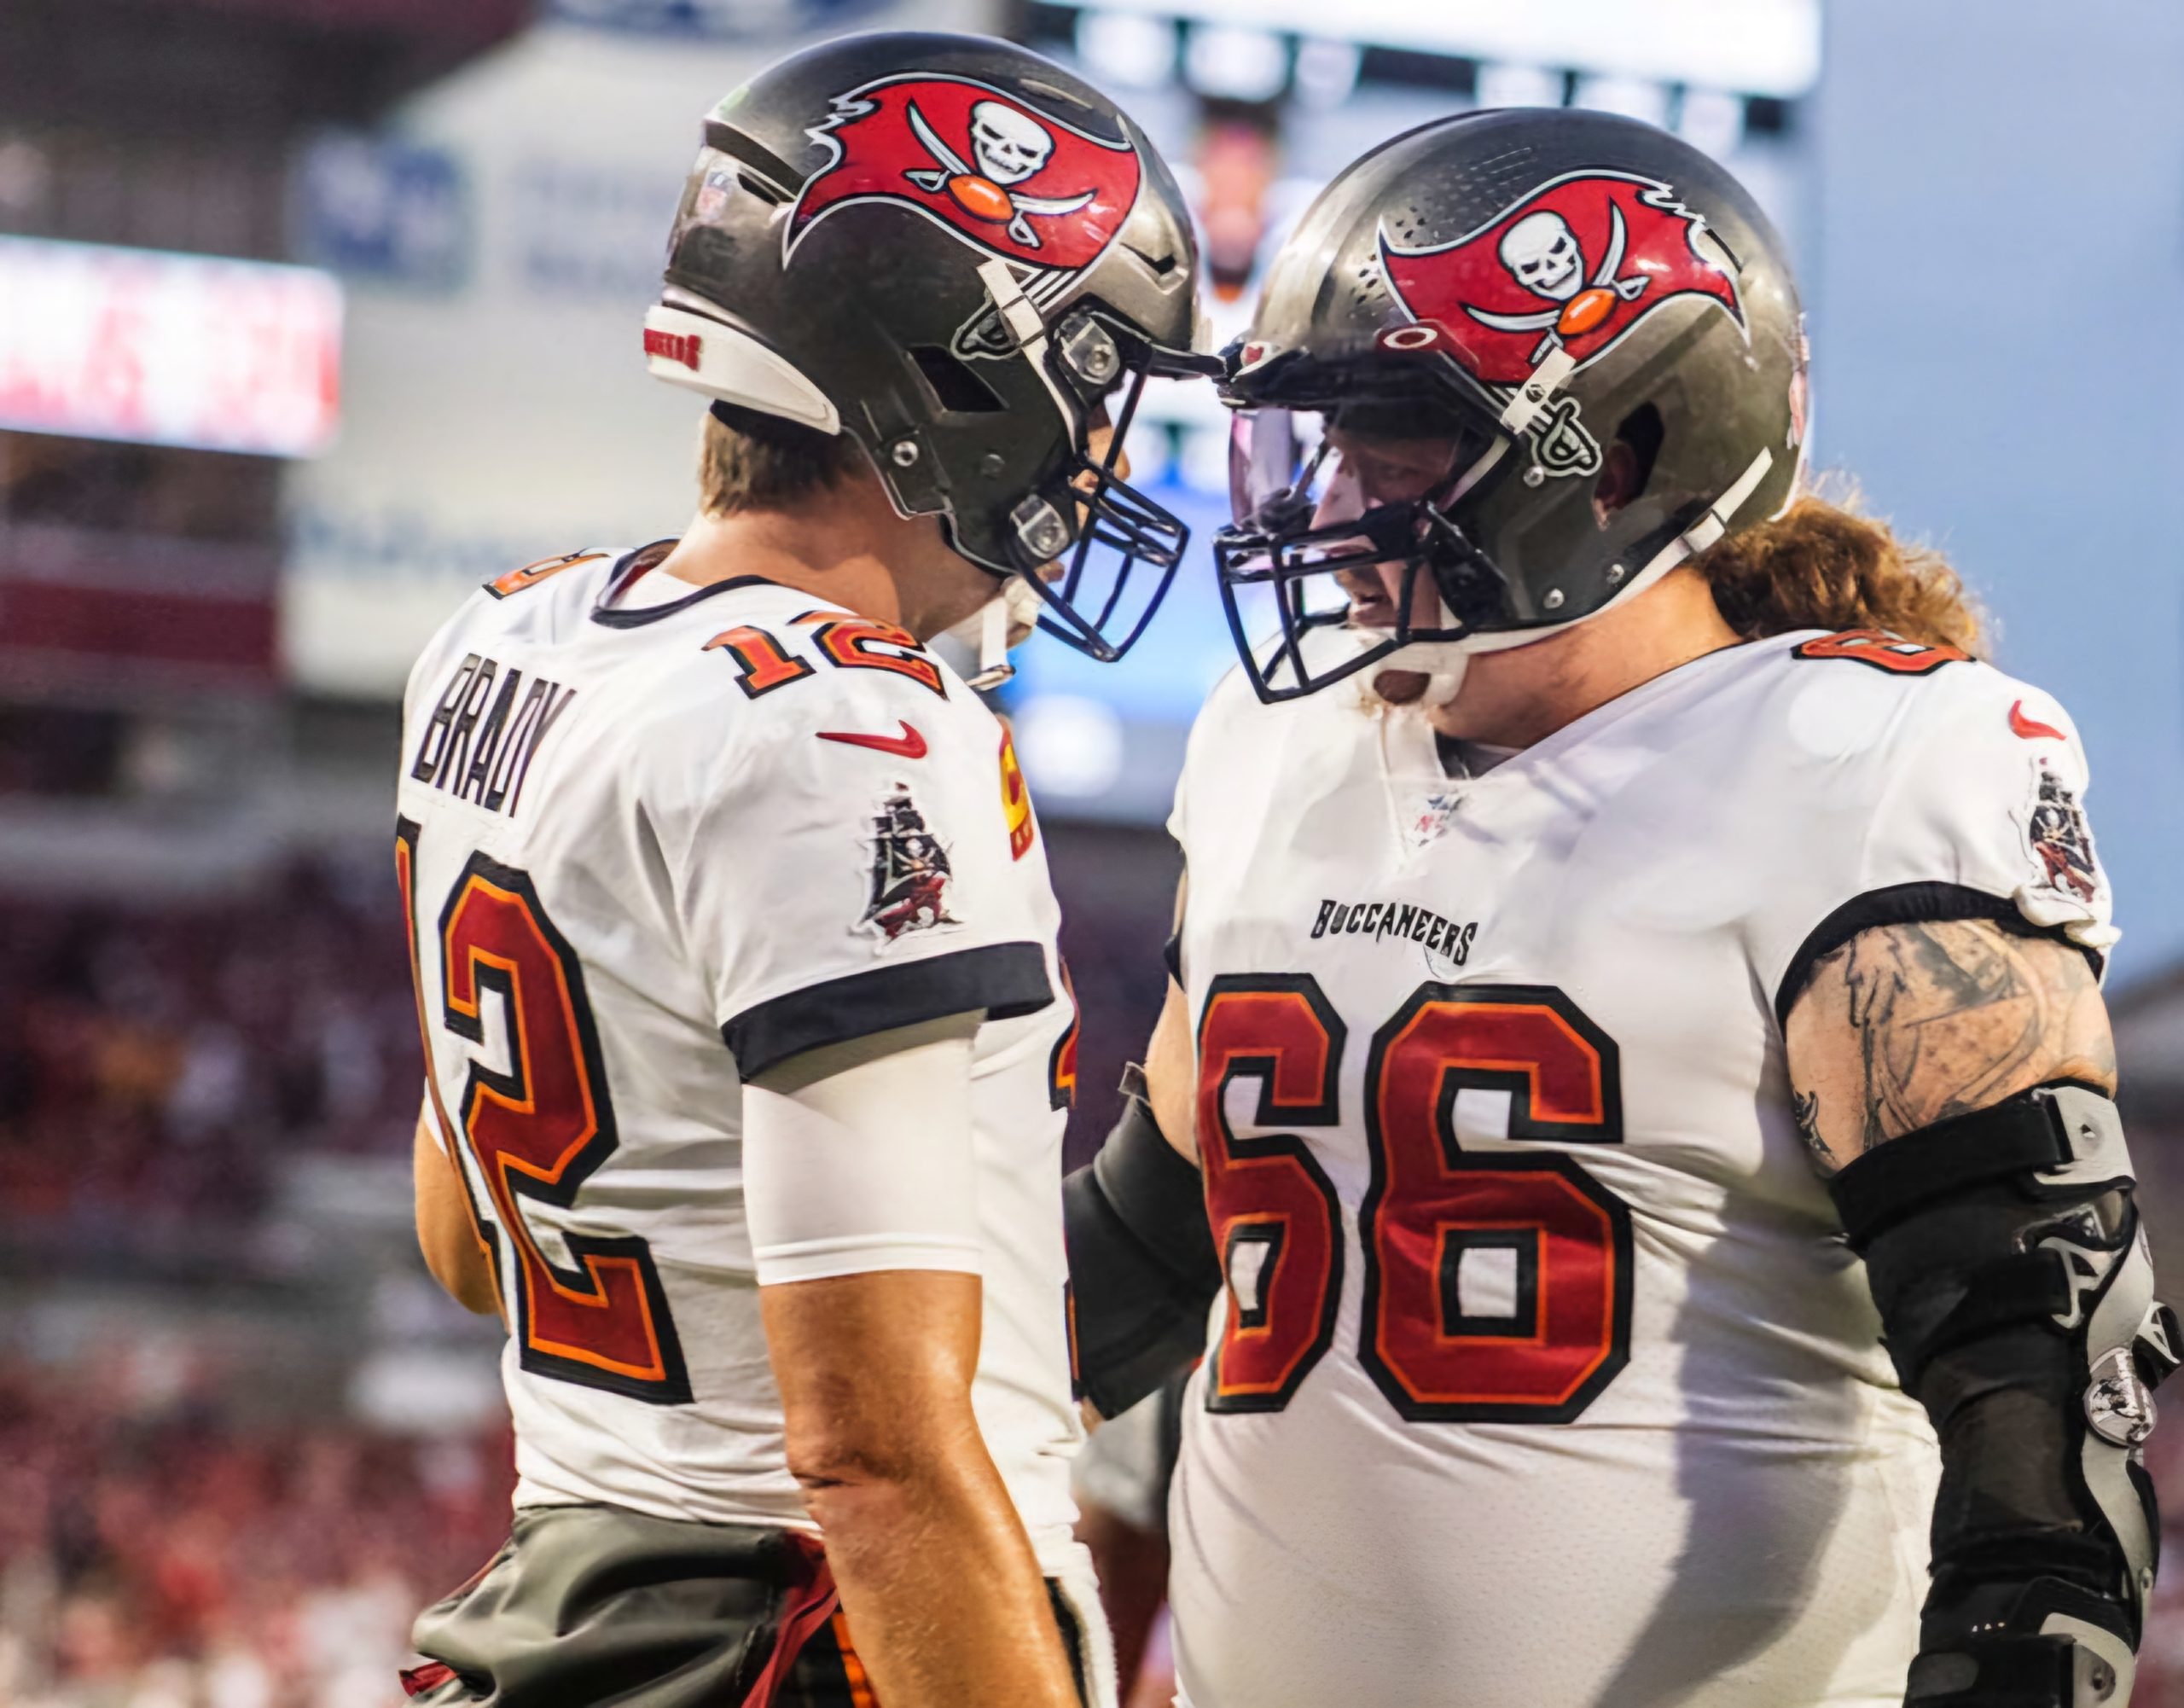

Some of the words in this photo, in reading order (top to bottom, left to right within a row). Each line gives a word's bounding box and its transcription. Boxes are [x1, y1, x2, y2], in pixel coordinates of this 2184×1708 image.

[701, 610, 950, 701] 12
[410, 652, 578, 818] BRADY
[1310, 899, 1478, 967] BUCCANEERS
[1198, 973, 1635, 1424] 66
